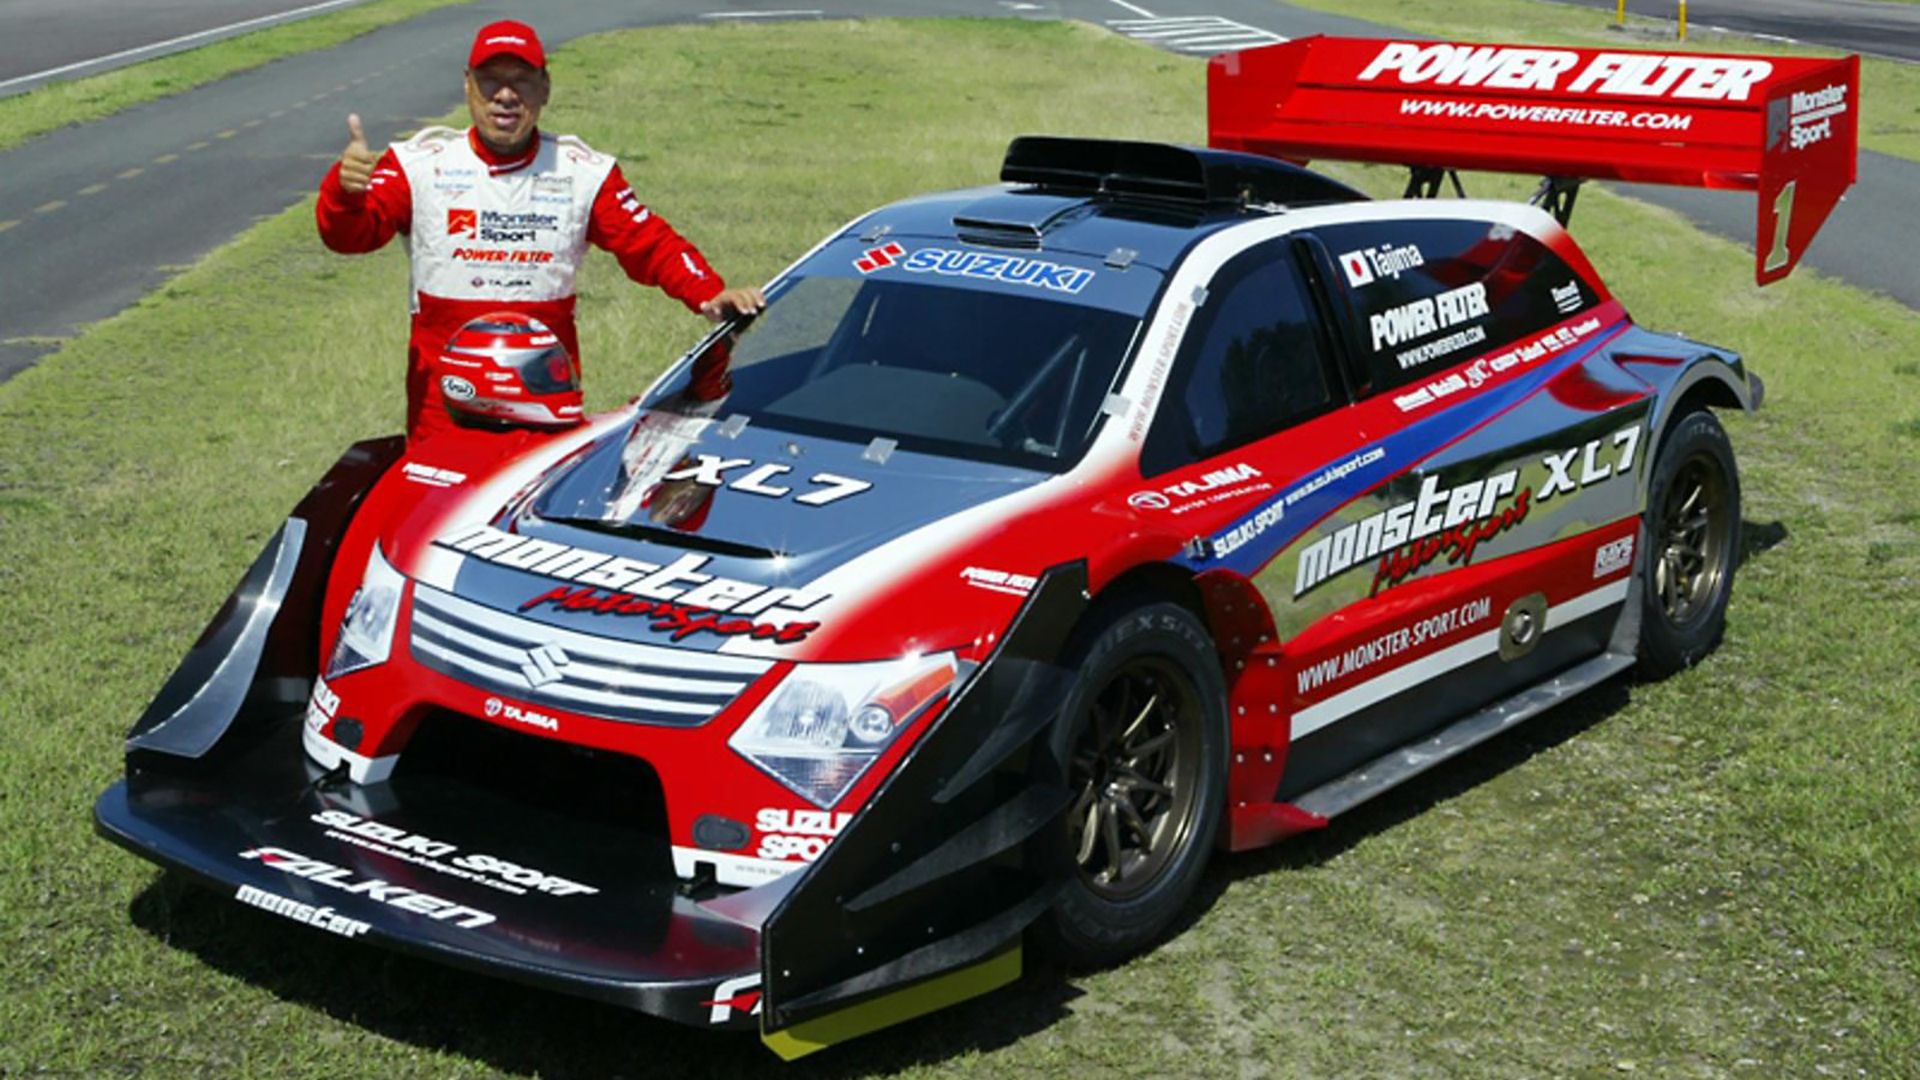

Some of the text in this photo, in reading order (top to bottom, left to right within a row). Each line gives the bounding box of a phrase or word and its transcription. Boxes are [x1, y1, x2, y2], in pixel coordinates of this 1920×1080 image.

[1356, 42, 1774, 101] POWER FILTER
[1400, 98, 1693, 131] WWW.POWERFILTER.COM
[1790, 84, 1847, 114] Monster
[1789, 118, 1832, 150] Sport
[480, 210, 558, 225] Monster
[480, 228, 536, 242] Sport
[1763, 179, 1796, 273] 1
[452, 247, 509, 263] POWER
[903, 247, 1096, 294] SUZUKI
[1365, 243, 1425, 280] Tajima
[1369, 297, 1438, 352] POWER
[1434, 281, 1490, 329] FILTER
[661, 453, 875, 508] XL7
[1164, 463, 1262, 498] TAJIMA
[1212, 499, 1287, 559] SUZUKI SPORT
[1293, 425, 1641, 601] monster XL7
[430, 521, 834, 616] monster
[1296, 597, 1492, 695] WWW.MONSTER-SPORT.COM
[503, 705, 559, 731] TAJIMA
[755, 806, 854, 836] SUZU
[311, 809, 600, 897] SUZUKI SPORT
[757, 833, 834, 861] SPO
[238, 846, 499, 929] FALKEN
[234, 884, 374, 939] monster
